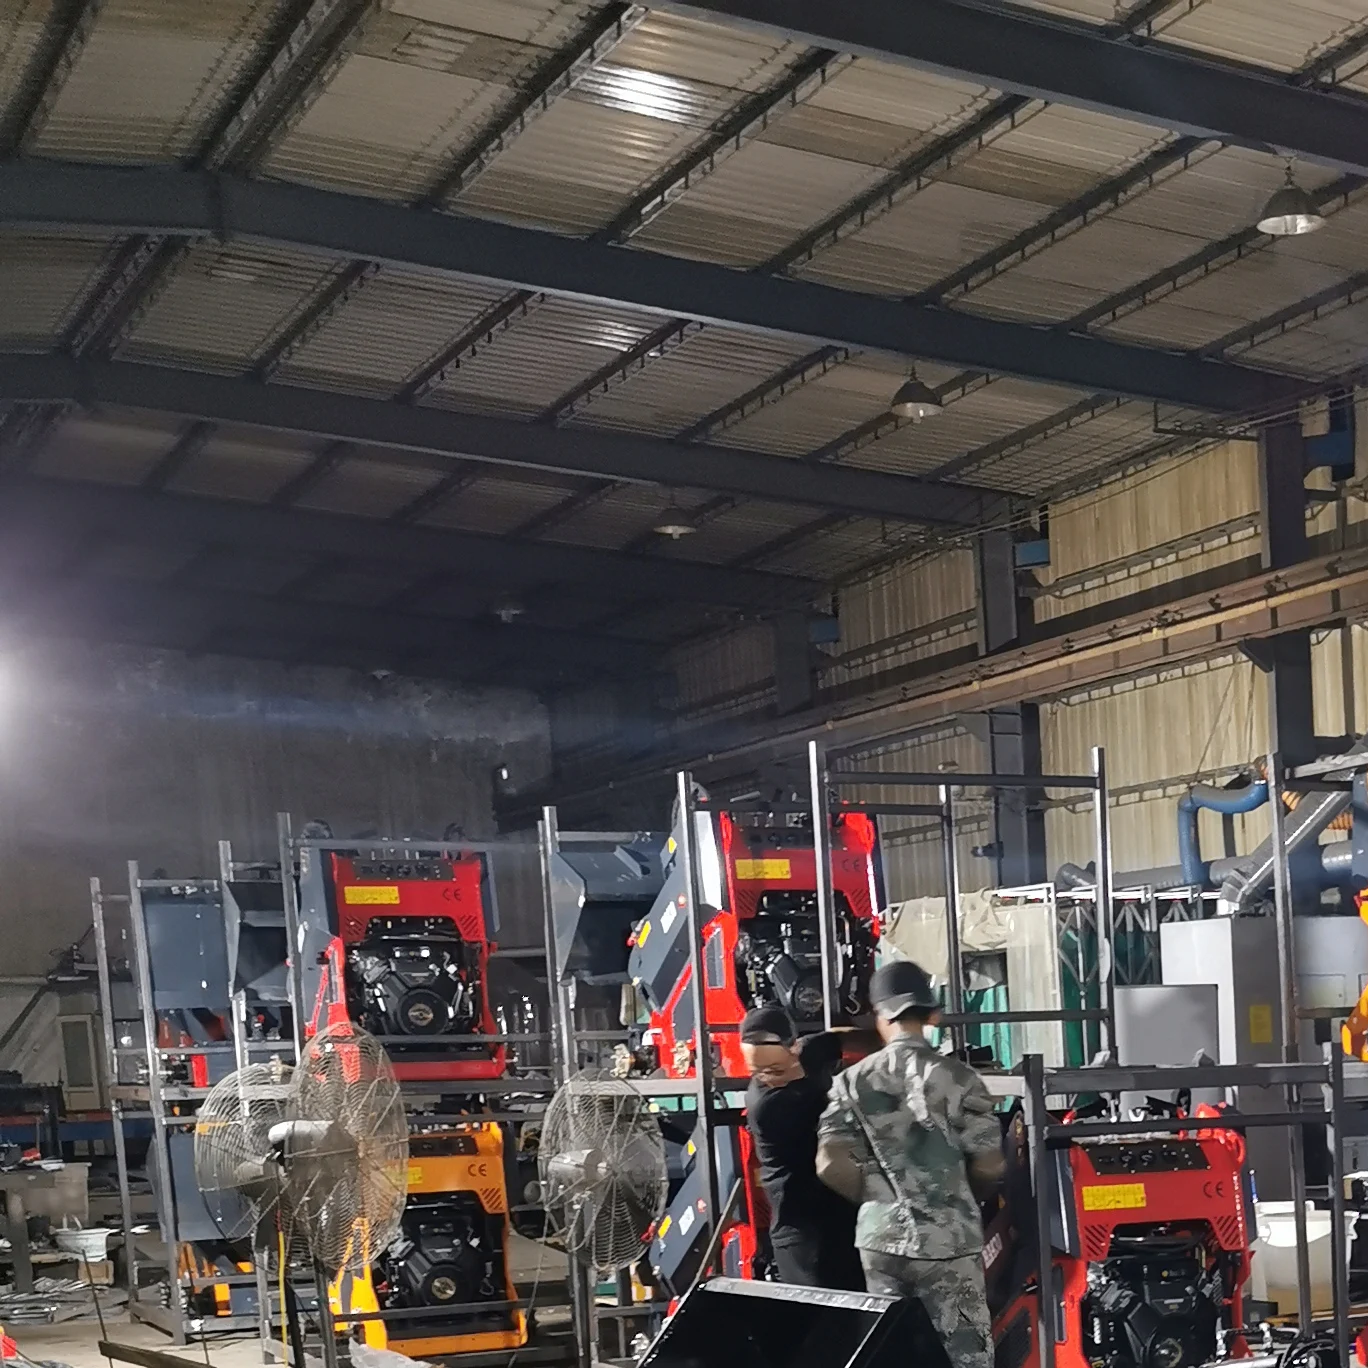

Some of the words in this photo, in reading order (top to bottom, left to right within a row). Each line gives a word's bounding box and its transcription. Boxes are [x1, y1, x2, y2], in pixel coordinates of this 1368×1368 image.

[442, 888, 462, 902] CE
[467, 1163, 487, 1177] CE
[1203, 1181, 1224, 1198] CE
